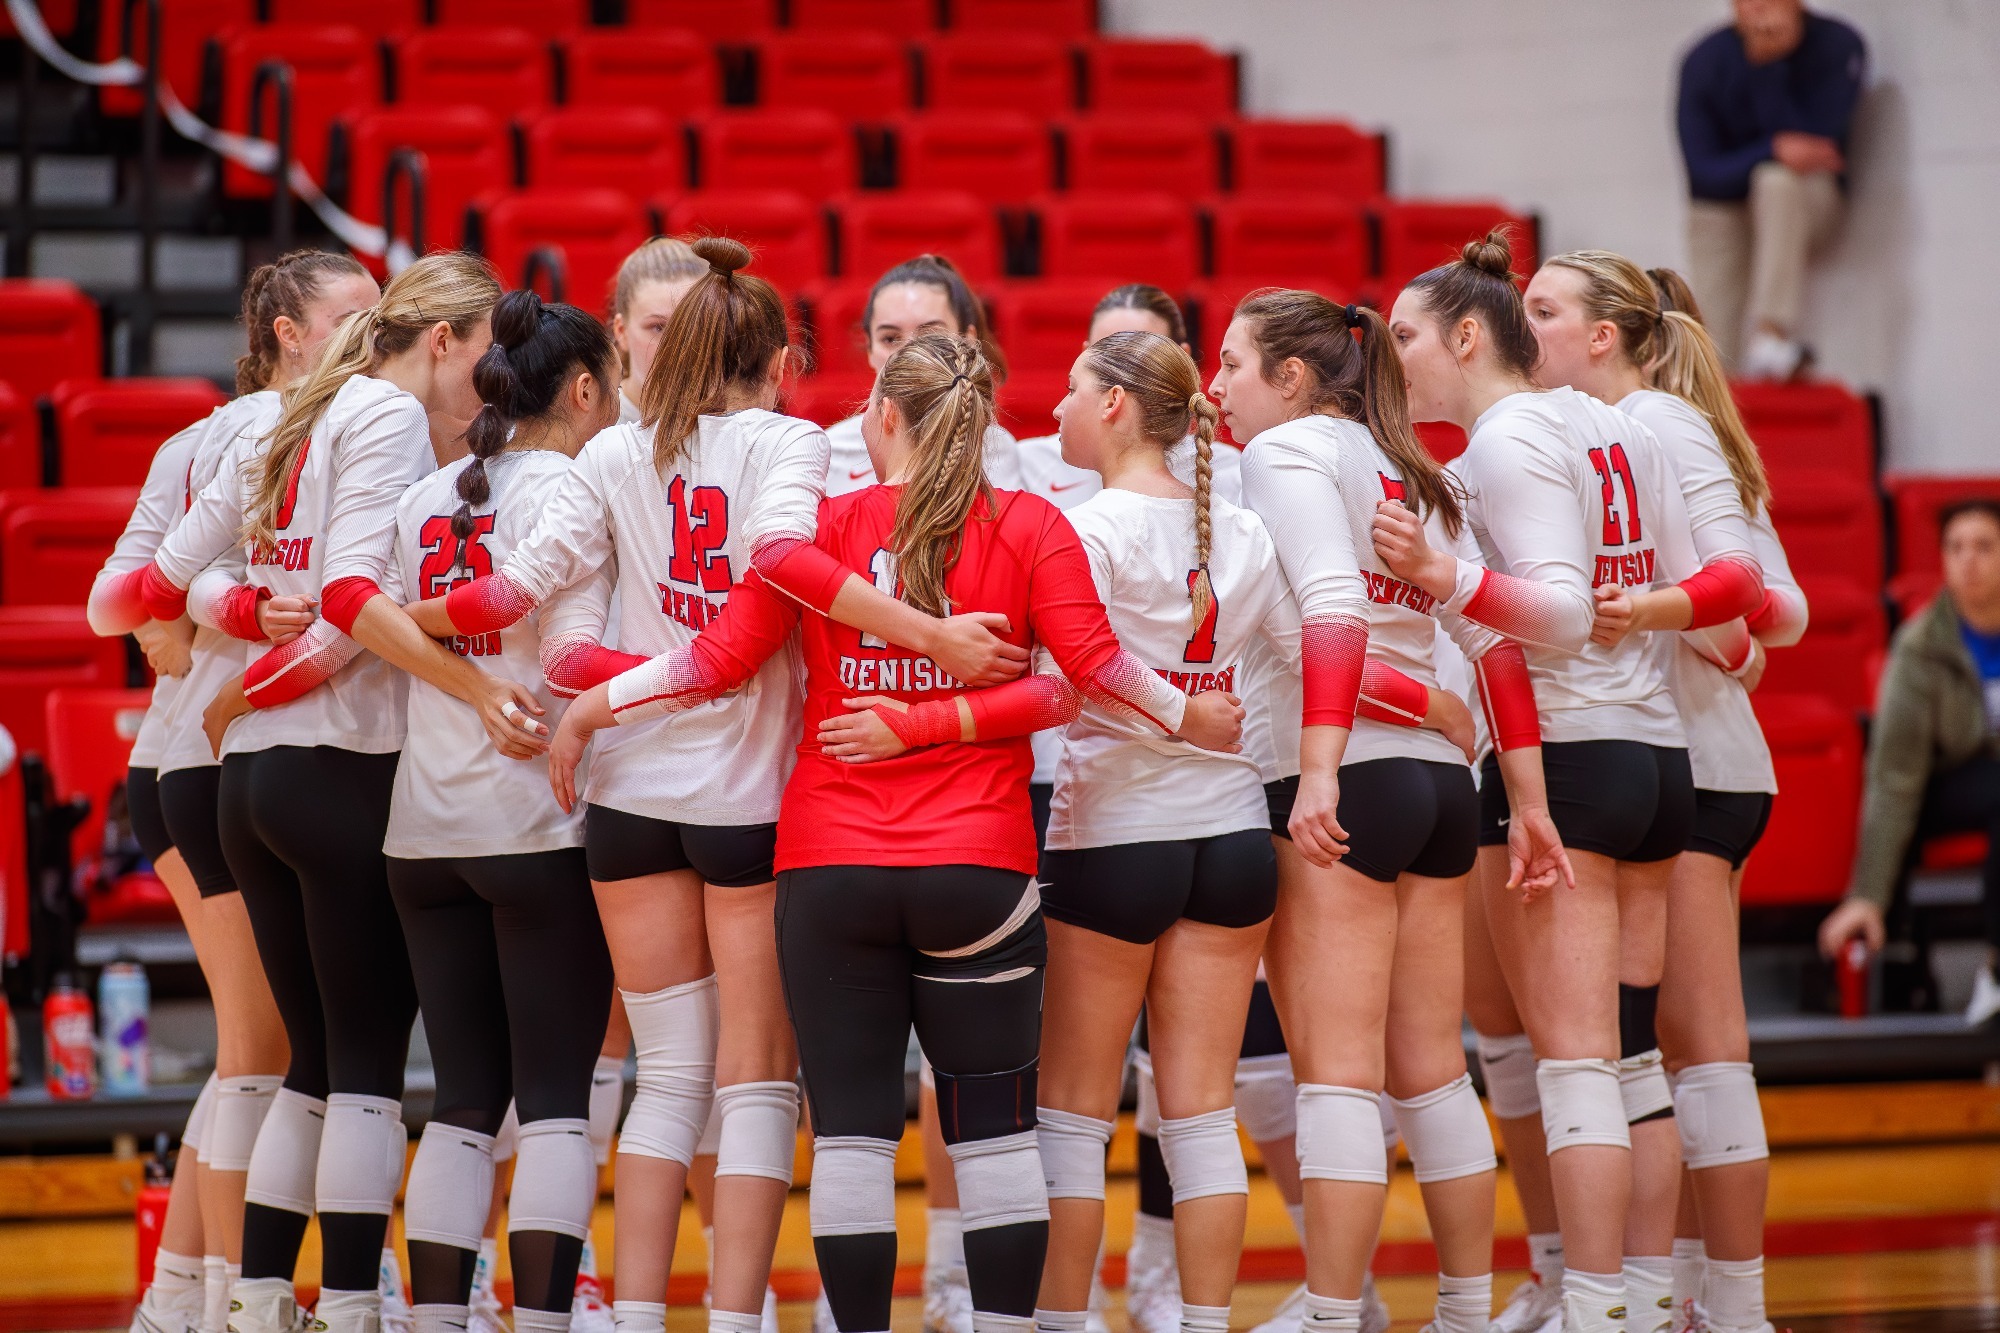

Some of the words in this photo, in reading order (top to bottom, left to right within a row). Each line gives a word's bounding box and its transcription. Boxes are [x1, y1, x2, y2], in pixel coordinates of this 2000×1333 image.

[667, 474, 734, 594] 12
[1588, 442, 1642, 547] 21
[419, 509, 497, 601] 25
[839, 655, 967, 692] DENISO
